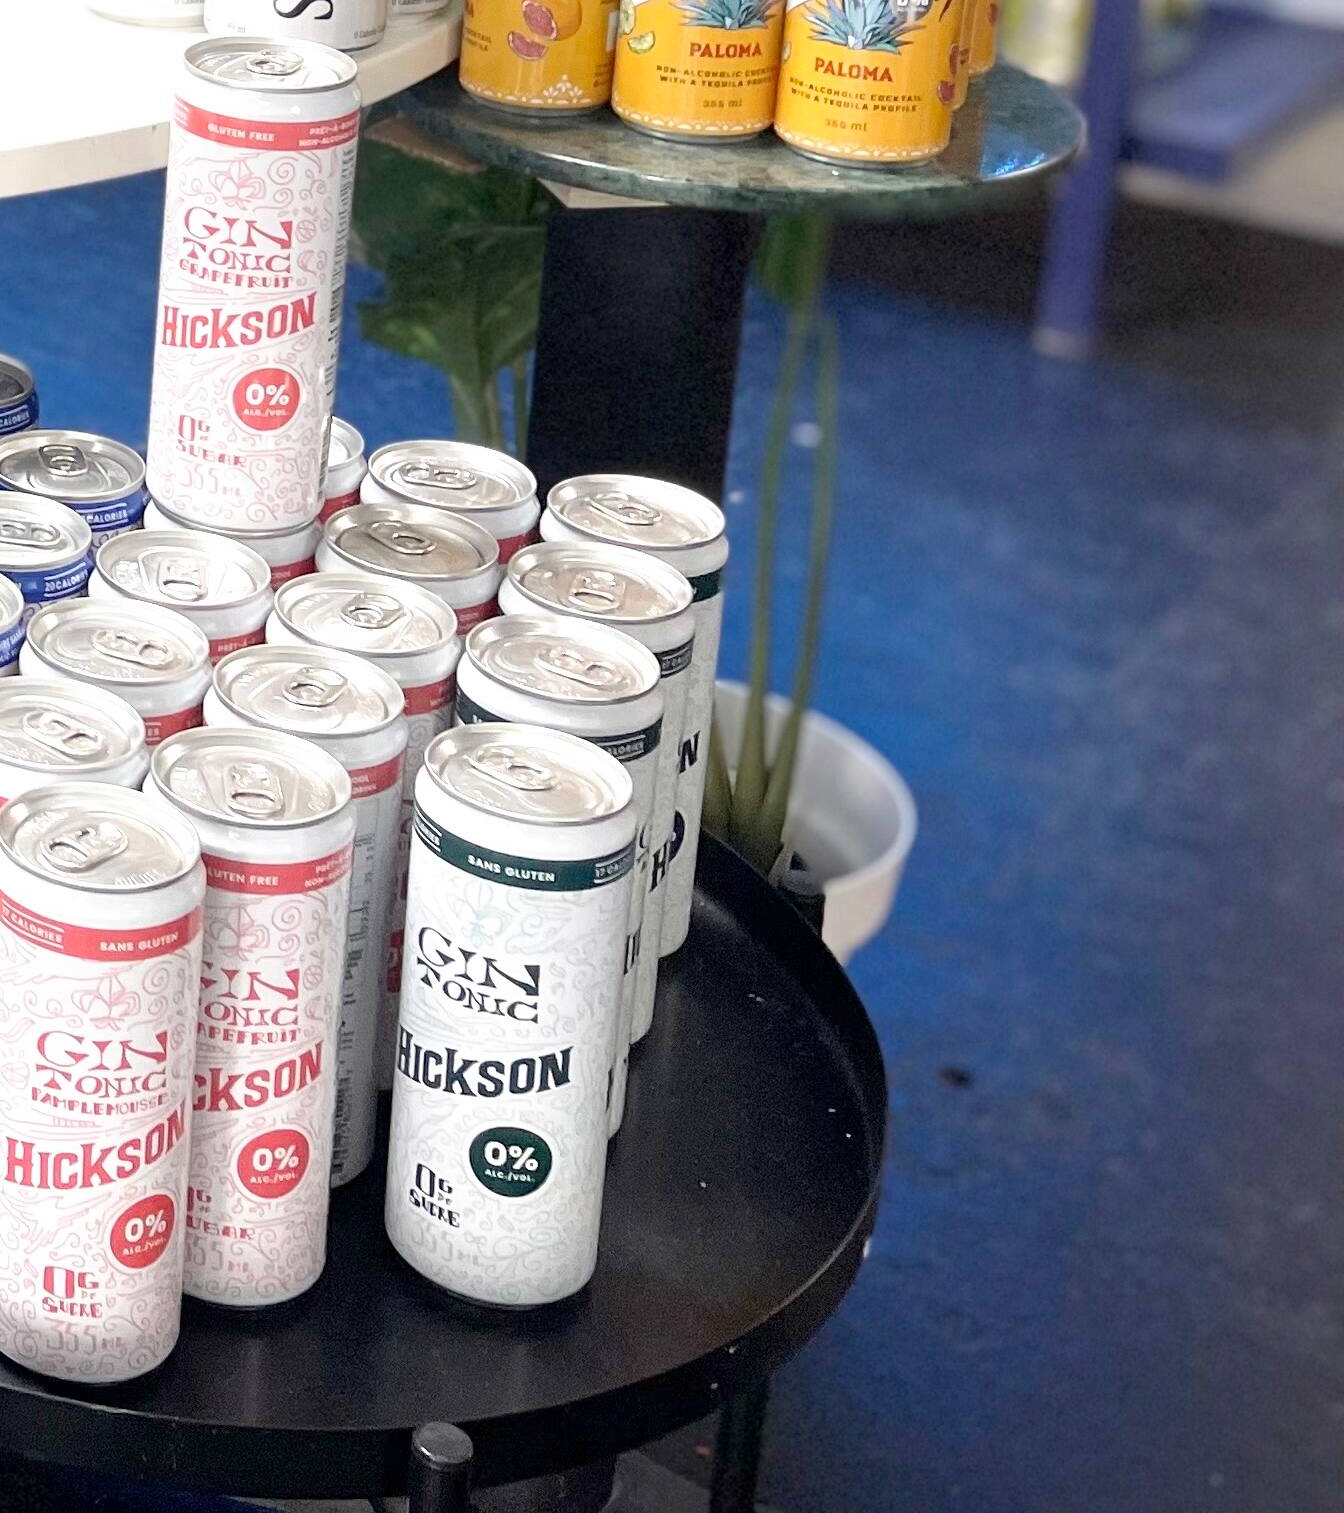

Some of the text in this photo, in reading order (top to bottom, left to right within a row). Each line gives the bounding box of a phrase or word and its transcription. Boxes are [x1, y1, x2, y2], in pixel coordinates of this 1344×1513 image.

[690, 43, 762, 59] PALOMA
[815, 57, 893, 83] PALOMA
[823, 98, 868, 111] TEQUILA
[871, 94, 922, 102] COCKTAIL
[208, 123, 275, 142] GLUTEN FREE
[184, 206, 293, 249] GIN
[183, 237, 291, 274] TONIC
[179, 258, 293, 288] GRAPEFRUIT
[162, 292, 317, 349] HICKSON
[245, 383, 289, 406] 0%
[250, 875, 279, 886] FREE
[468, 855, 555, 882] SANS GLUTEN
[11, 911, 62, 943] CALORIES
[100, 932, 178, 952] SANS GLUTEN
[418, 927, 540, 996] GIN
[417, 957, 538, 1024] TONIC
[204, 1000, 299, 1026] ONIC
[36, 1030, 167, 1072] GIN
[398, 1024, 574, 1098] HICKSON
[36, 1063, 166, 1098] TONIC
[32, 1087, 168, 1116] PAMPLEMOUSSE
[5, 1098, 185, 1189] HICKSON
[252, 1145, 298, 1171] 0%
[484, 1141, 538, 1172] 0%
[124, 1210, 166, 1242] 0%
[42, 1297, 102, 1318] SUCRE
